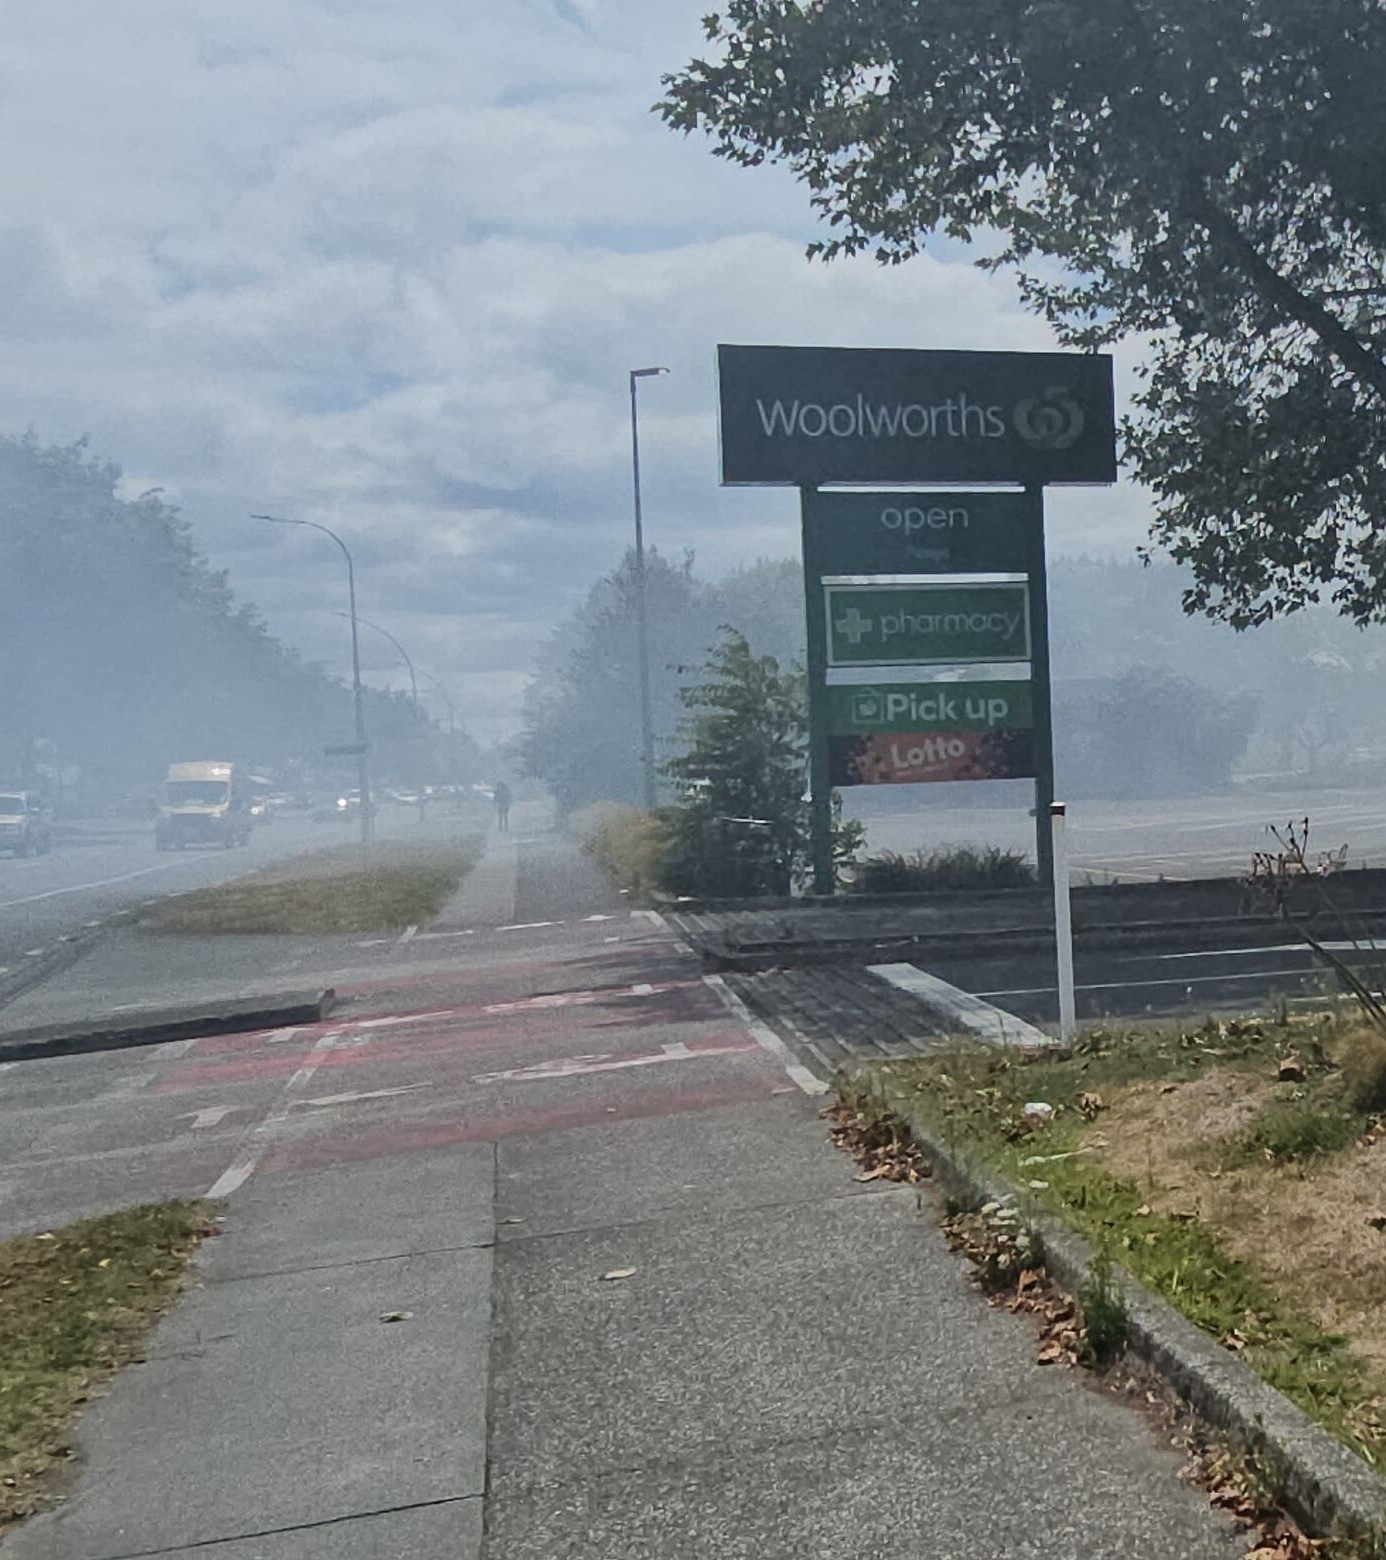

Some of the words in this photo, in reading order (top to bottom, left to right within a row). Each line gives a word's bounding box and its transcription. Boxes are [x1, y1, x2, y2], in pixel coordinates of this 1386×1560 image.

[756, 393, 1005, 437] Woolworths
[881, 506, 969, 536] open
[880, 608, 1020, 642] pharmacy
[887, 693, 957, 721] Pick
[966, 699, 1008, 726] up
[890, 737, 965, 768] Lotto
